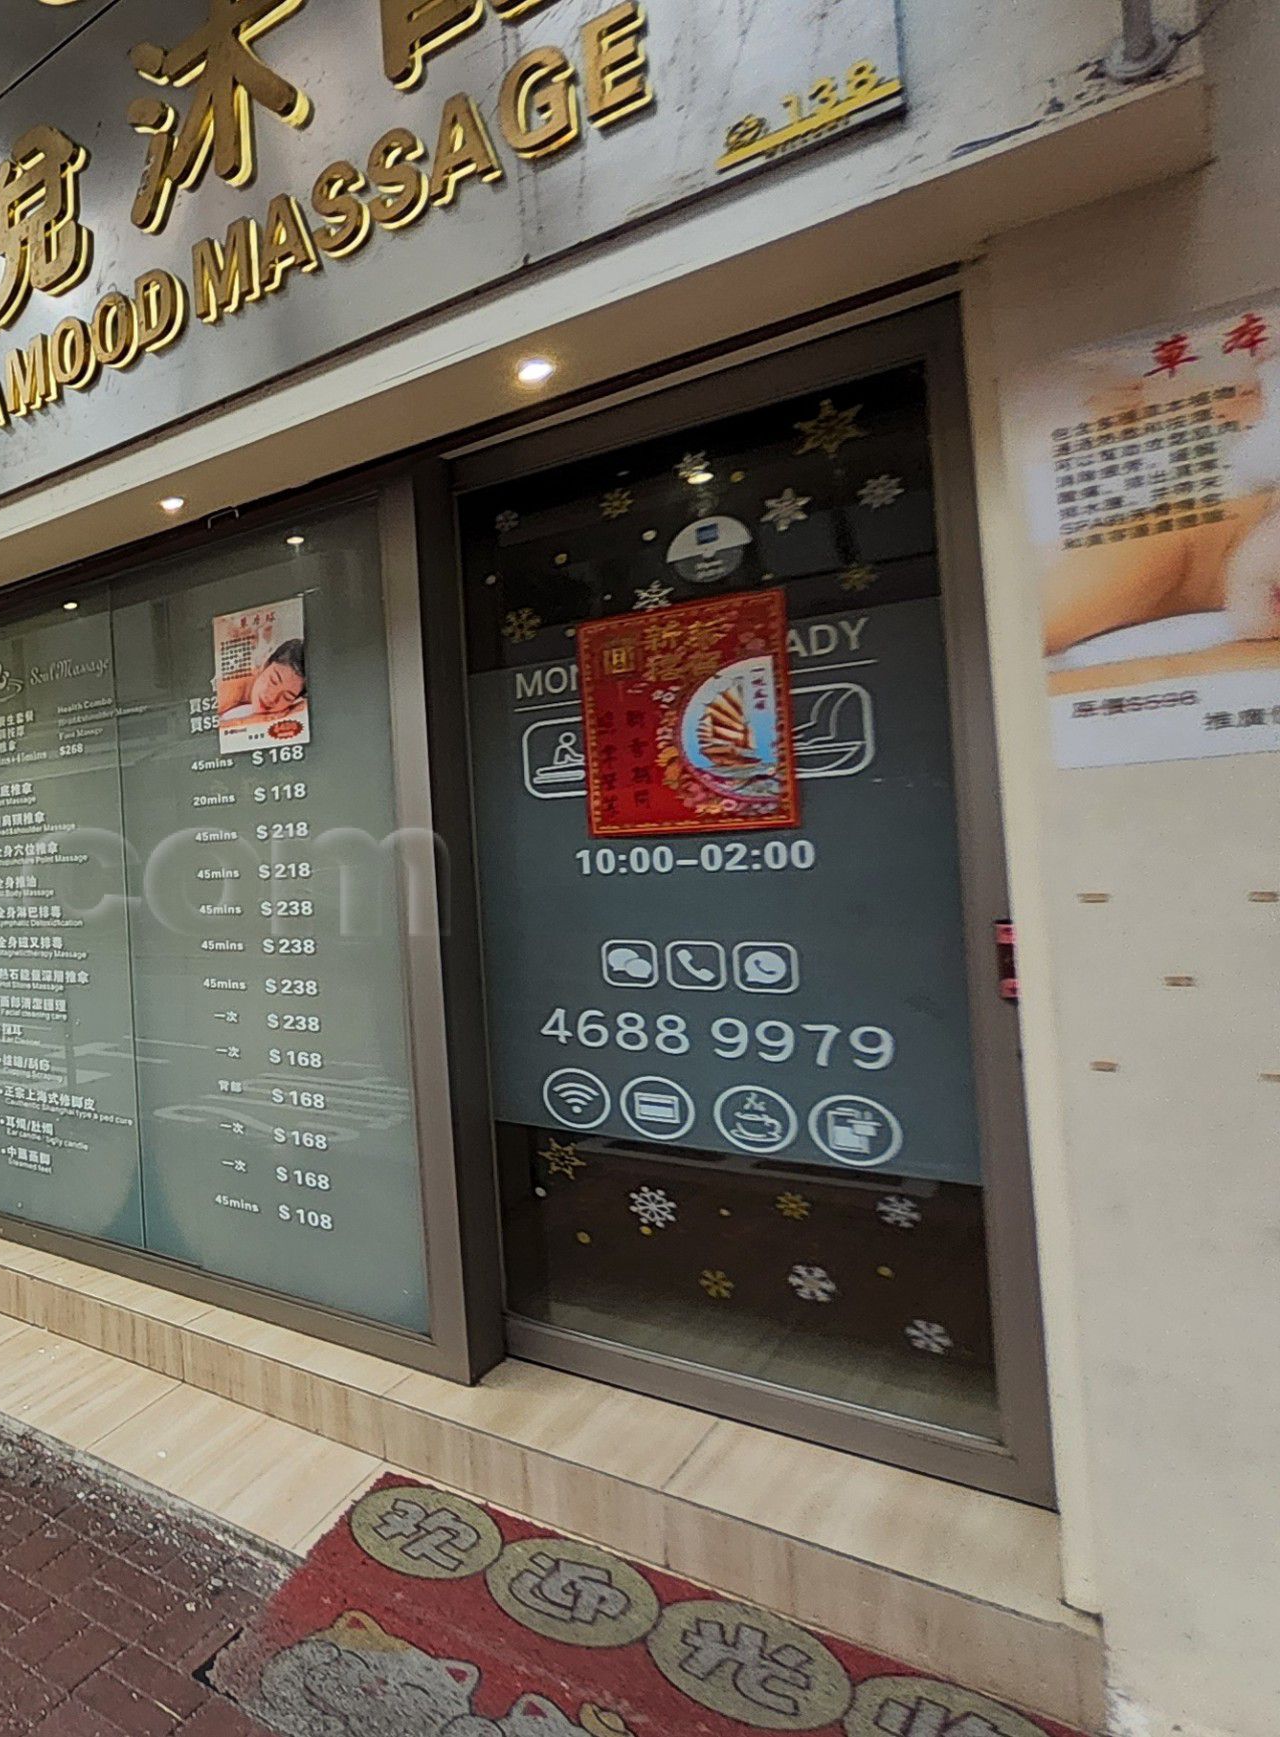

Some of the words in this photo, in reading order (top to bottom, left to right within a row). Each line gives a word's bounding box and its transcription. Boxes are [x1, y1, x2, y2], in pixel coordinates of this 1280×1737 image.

[780, 58, 878, 123] 138
[4, 268, 186, 417] MOOD
[192, 2, 656, 324] MASSAGE
[515, 664, 578, 699] MO
[59, 743, 84, 757] $268
[269, 746, 304, 763] 168
[191, 758, 234, 771] 45mins
[193, 793, 236, 806] 20mins
[271, 783, 306, 800] 118
[195, 830, 238, 842] 45mins
[272, 822, 309, 839] 218
[197, 868, 240, 879] 45mins
[274, 862, 311, 878] 218
[199, 904, 242, 915] 45mins
[277, 901, 313, 916] 238
[201, 940, 244, 951] 45mins
[278, 939, 315, 953] 238
[203, 978, 247, 990] 45mins
[281, 979, 318, 995] 238
[283, 1015, 320, 1031] 238
[540, 1008, 690, 1056] 4688
[710, 1017, 895, 1071] 9979
[287, 1050, 322, 1068] 168
[289, 1090, 325, 1109] 168
[291, 1130, 327, 1150] 168
[293, 1170, 330, 1190] 168
[215, 1194, 260, 1213] 45mins
[296, 1209, 333, 1230] 108
